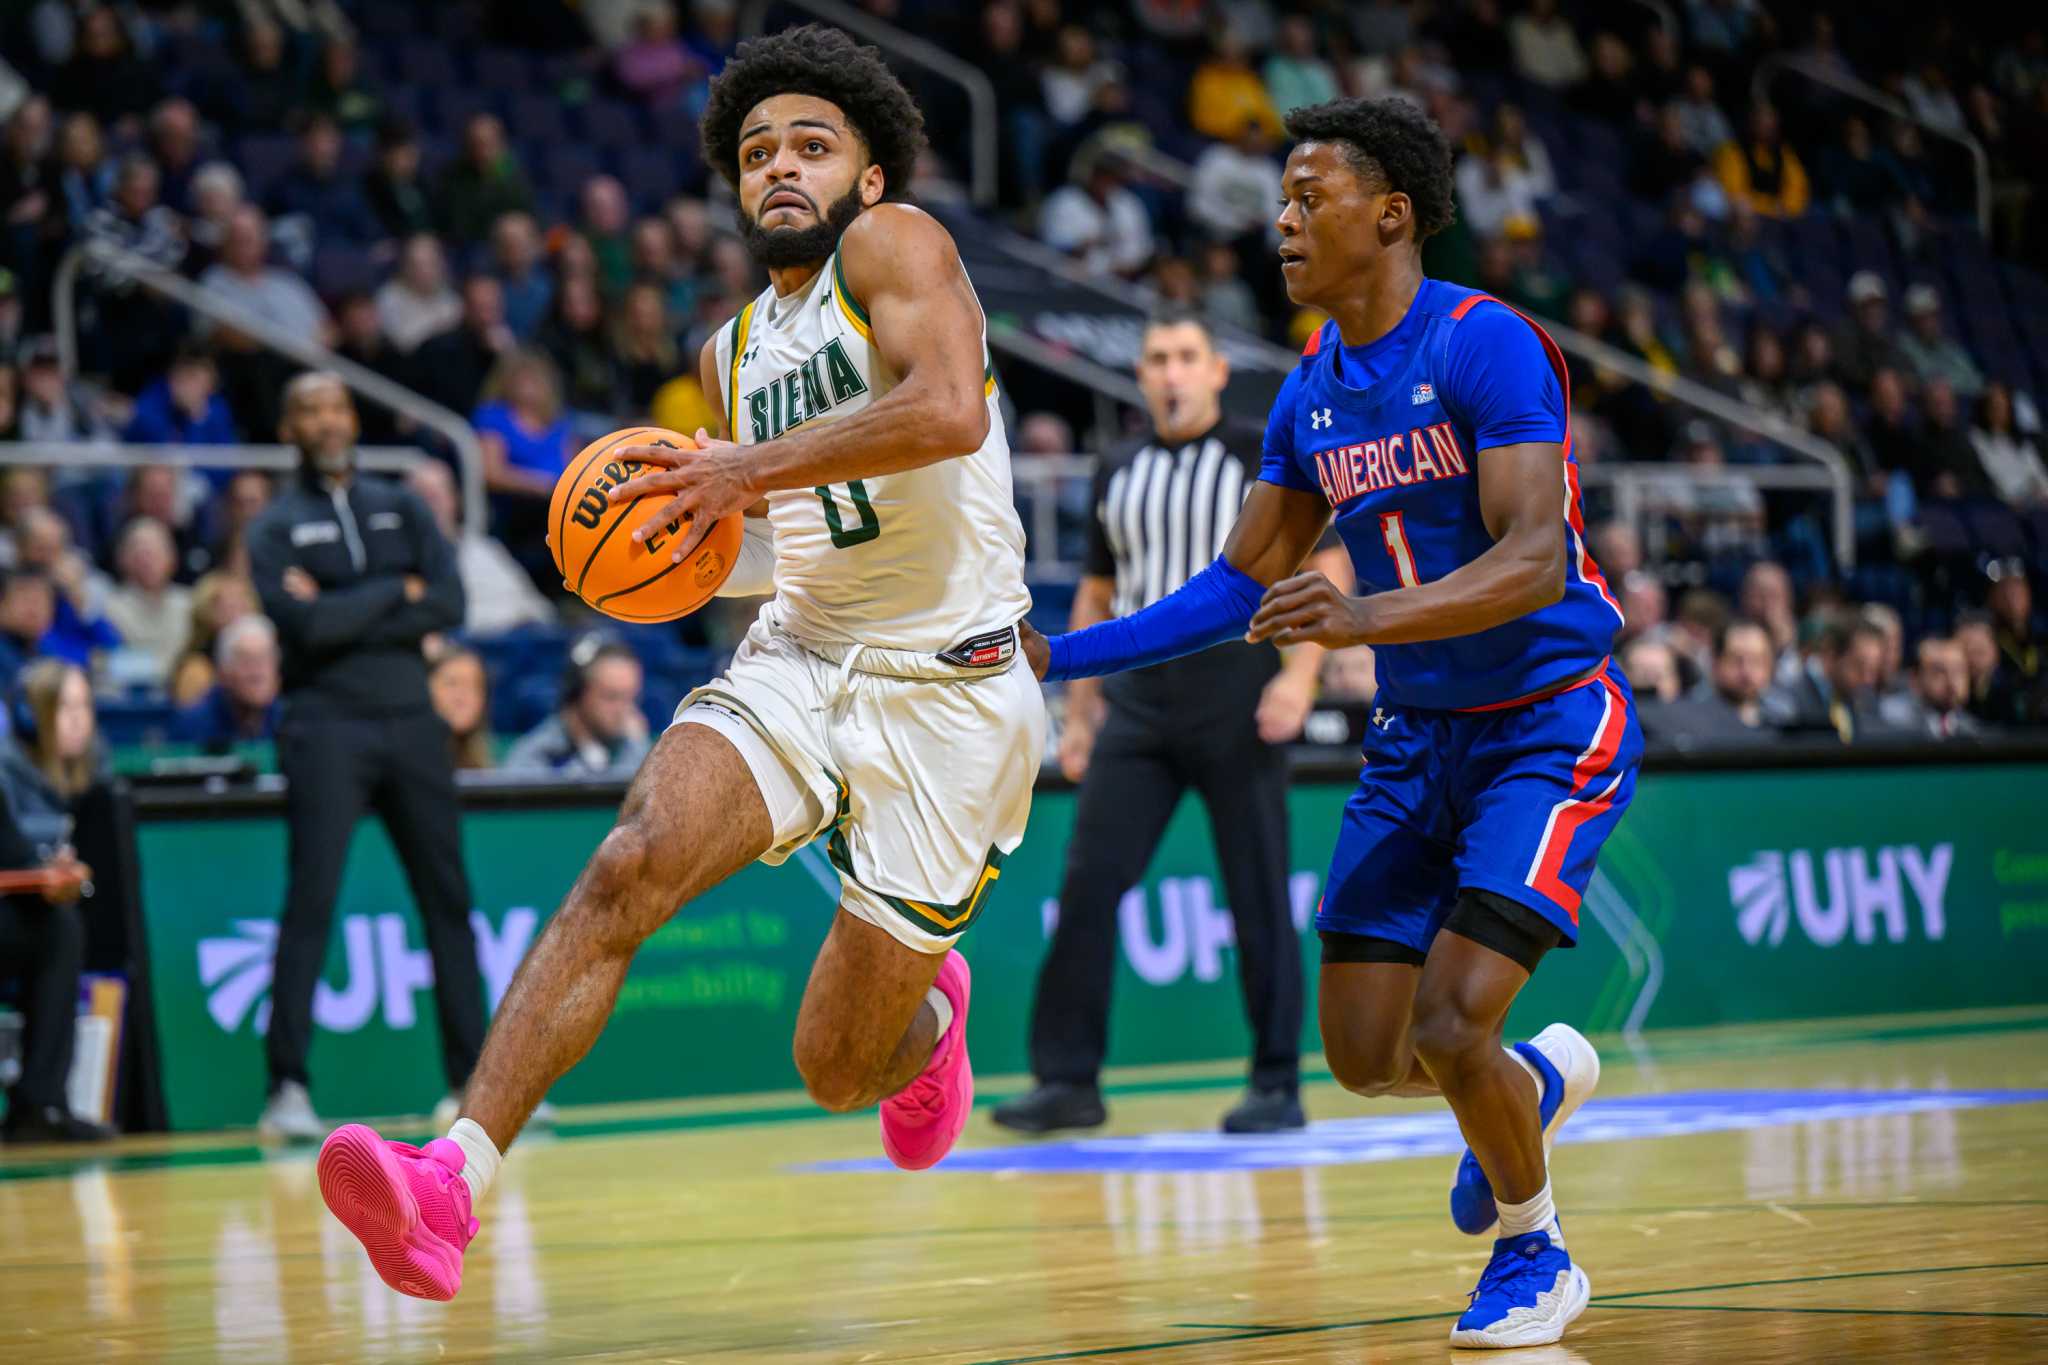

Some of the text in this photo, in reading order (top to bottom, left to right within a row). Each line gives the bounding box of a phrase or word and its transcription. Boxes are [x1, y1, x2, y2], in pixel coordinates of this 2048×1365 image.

[744, 336, 869, 444] SIENA
[1314, 420, 1471, 510] AMERICAN
[1378, 509, 1423, 589] 1
[1789, 841, 1953, 946] UHY
